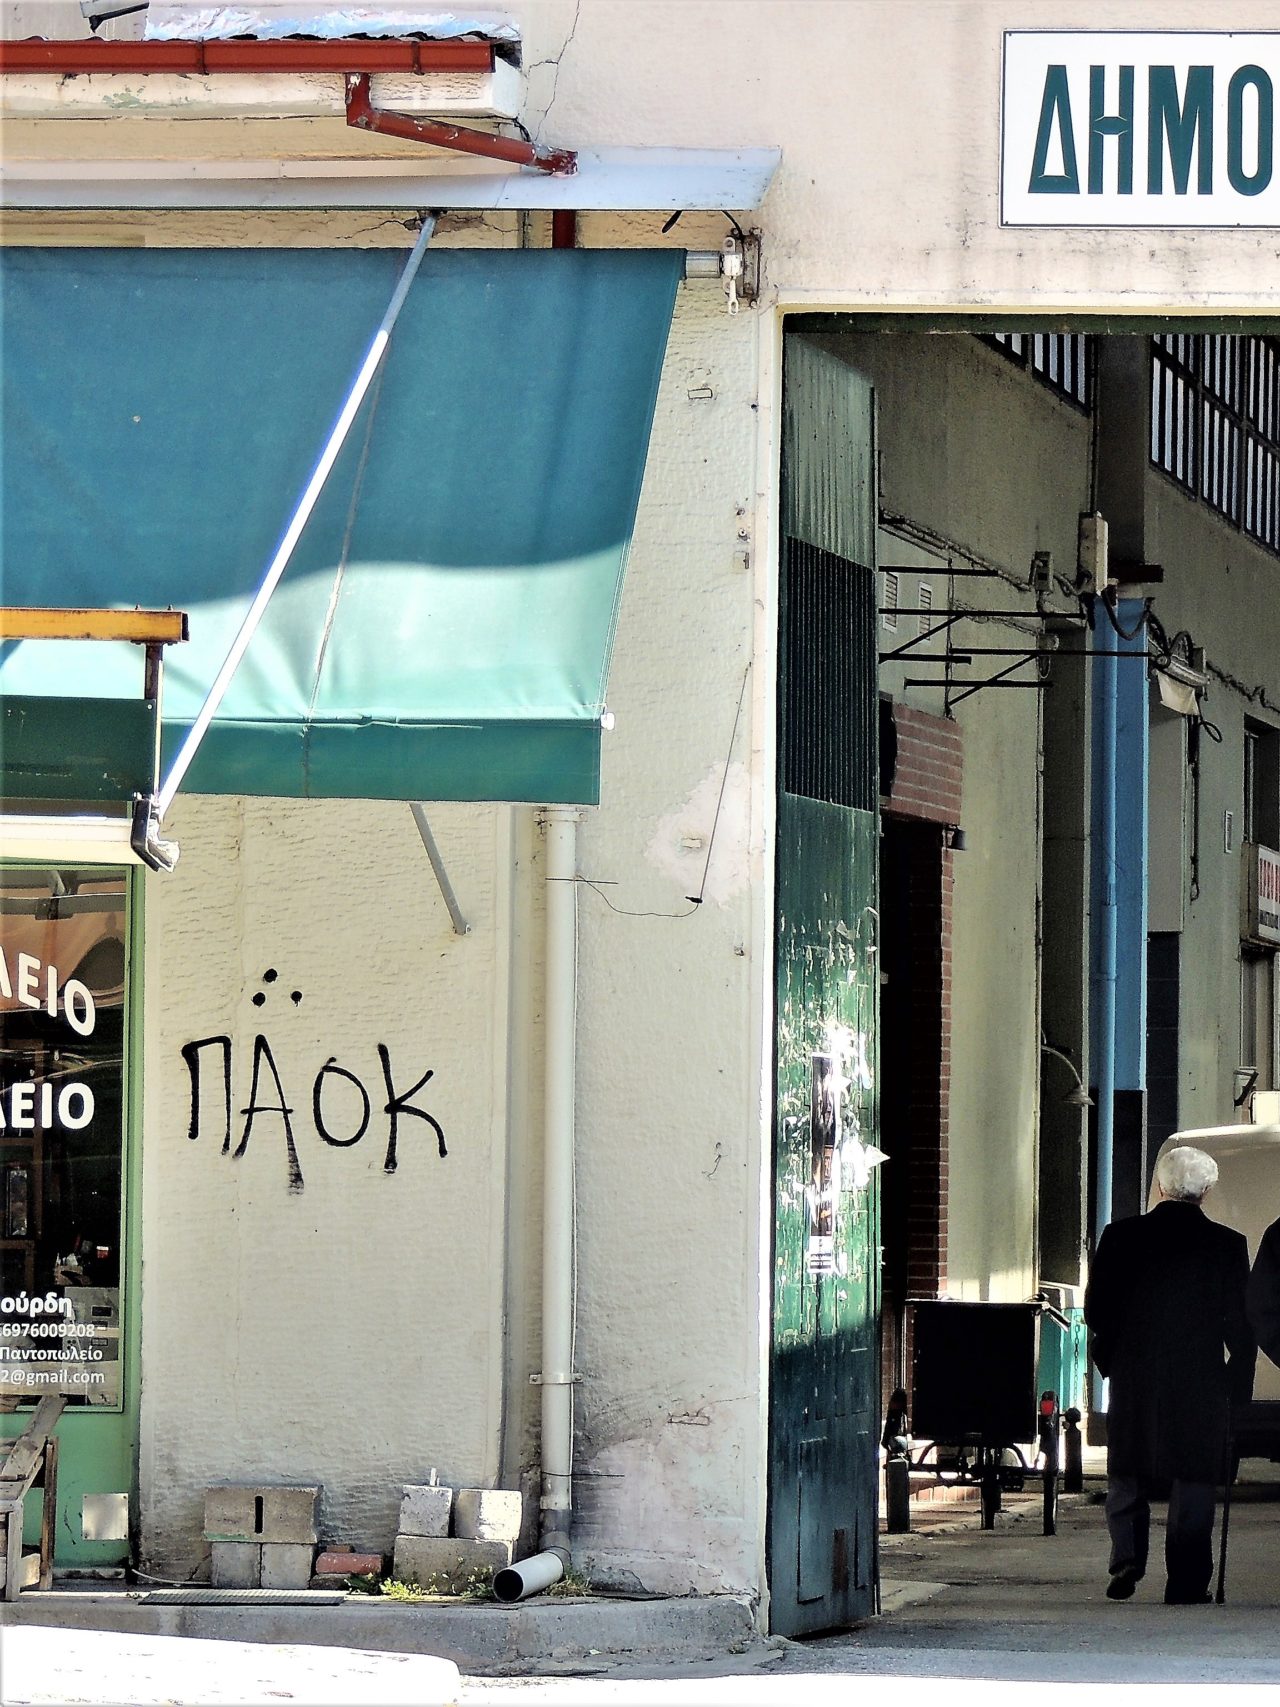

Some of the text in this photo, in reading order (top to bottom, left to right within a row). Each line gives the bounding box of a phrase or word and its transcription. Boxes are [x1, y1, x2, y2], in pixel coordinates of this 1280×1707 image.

[0, 1082, 95, 1130] ΕΙΟ
[181, 1033, 449, 1195] ΠΑΟΚ
[0, 1346, 103, 1361] Παντοπωλείο
